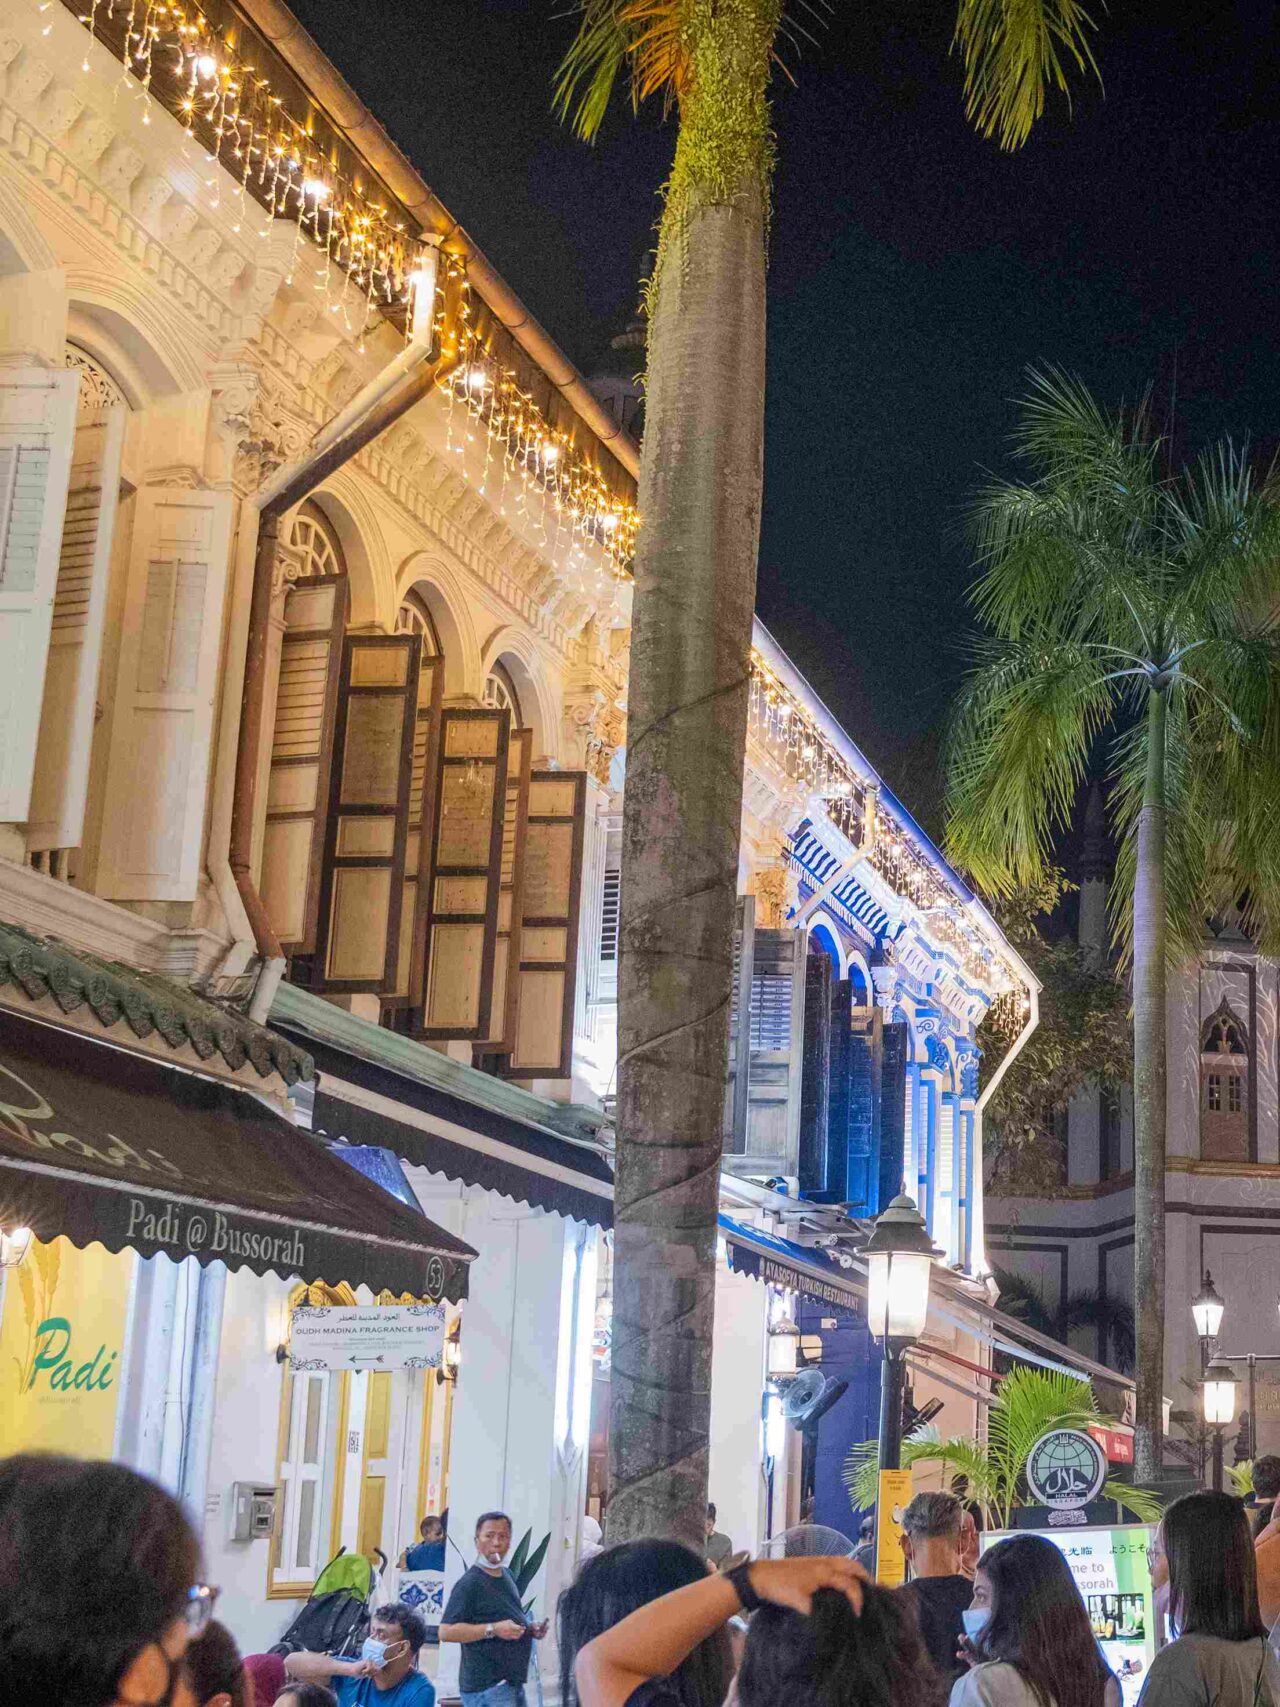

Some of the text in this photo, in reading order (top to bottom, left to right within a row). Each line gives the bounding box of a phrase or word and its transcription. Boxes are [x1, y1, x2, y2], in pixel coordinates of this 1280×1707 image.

[126, 1199, 305, 1267] Padi @ Bussorah
[429, 1266, 442, 1287] 53
[798, 1276, 824, 1298] TURKISH
[823, 1284, 859, 1311] RESTAURANT
[323, 1327, 357, 1335] MADINA
[359, 1325, 414, 1334] FRAGRANCE
[416, 1325, 440, 1333] SHOP
[28, 1316, 118, 1392] Padi
[1109, 1543, 1147, 1555] ようこそ
[1092, 1563, 1104, 1573] to
[1079, 1577, 1114, 1590] sorah
